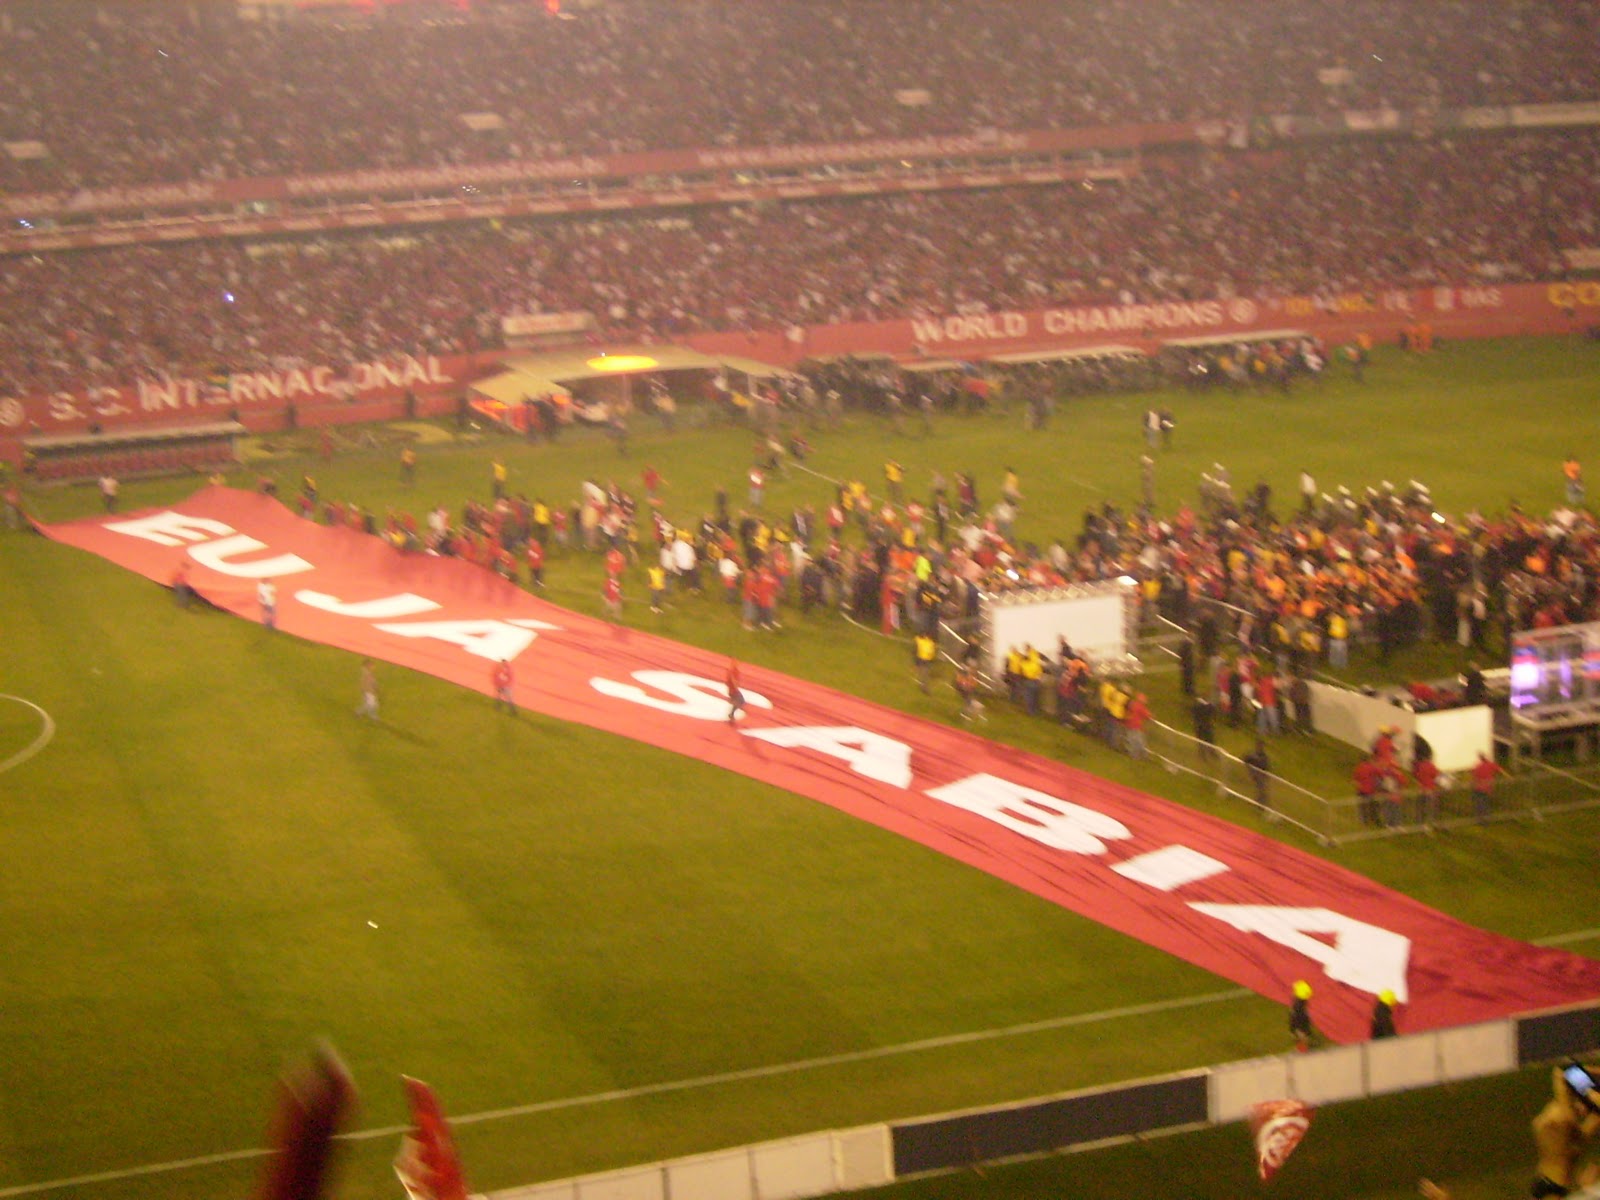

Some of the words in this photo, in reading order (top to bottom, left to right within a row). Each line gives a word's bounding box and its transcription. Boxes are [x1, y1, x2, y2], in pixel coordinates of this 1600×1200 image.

[911, 312, 1028, 343] WORLD
[1044, 302, 1223, 335] CHAMPIONS
[136, 355, 453, 412] INTERNACONAL
[102, 511, 314, 578] EU
[294, 590, 564, 663] JÁ
[590, 666, 1411, 1004] SABIA
